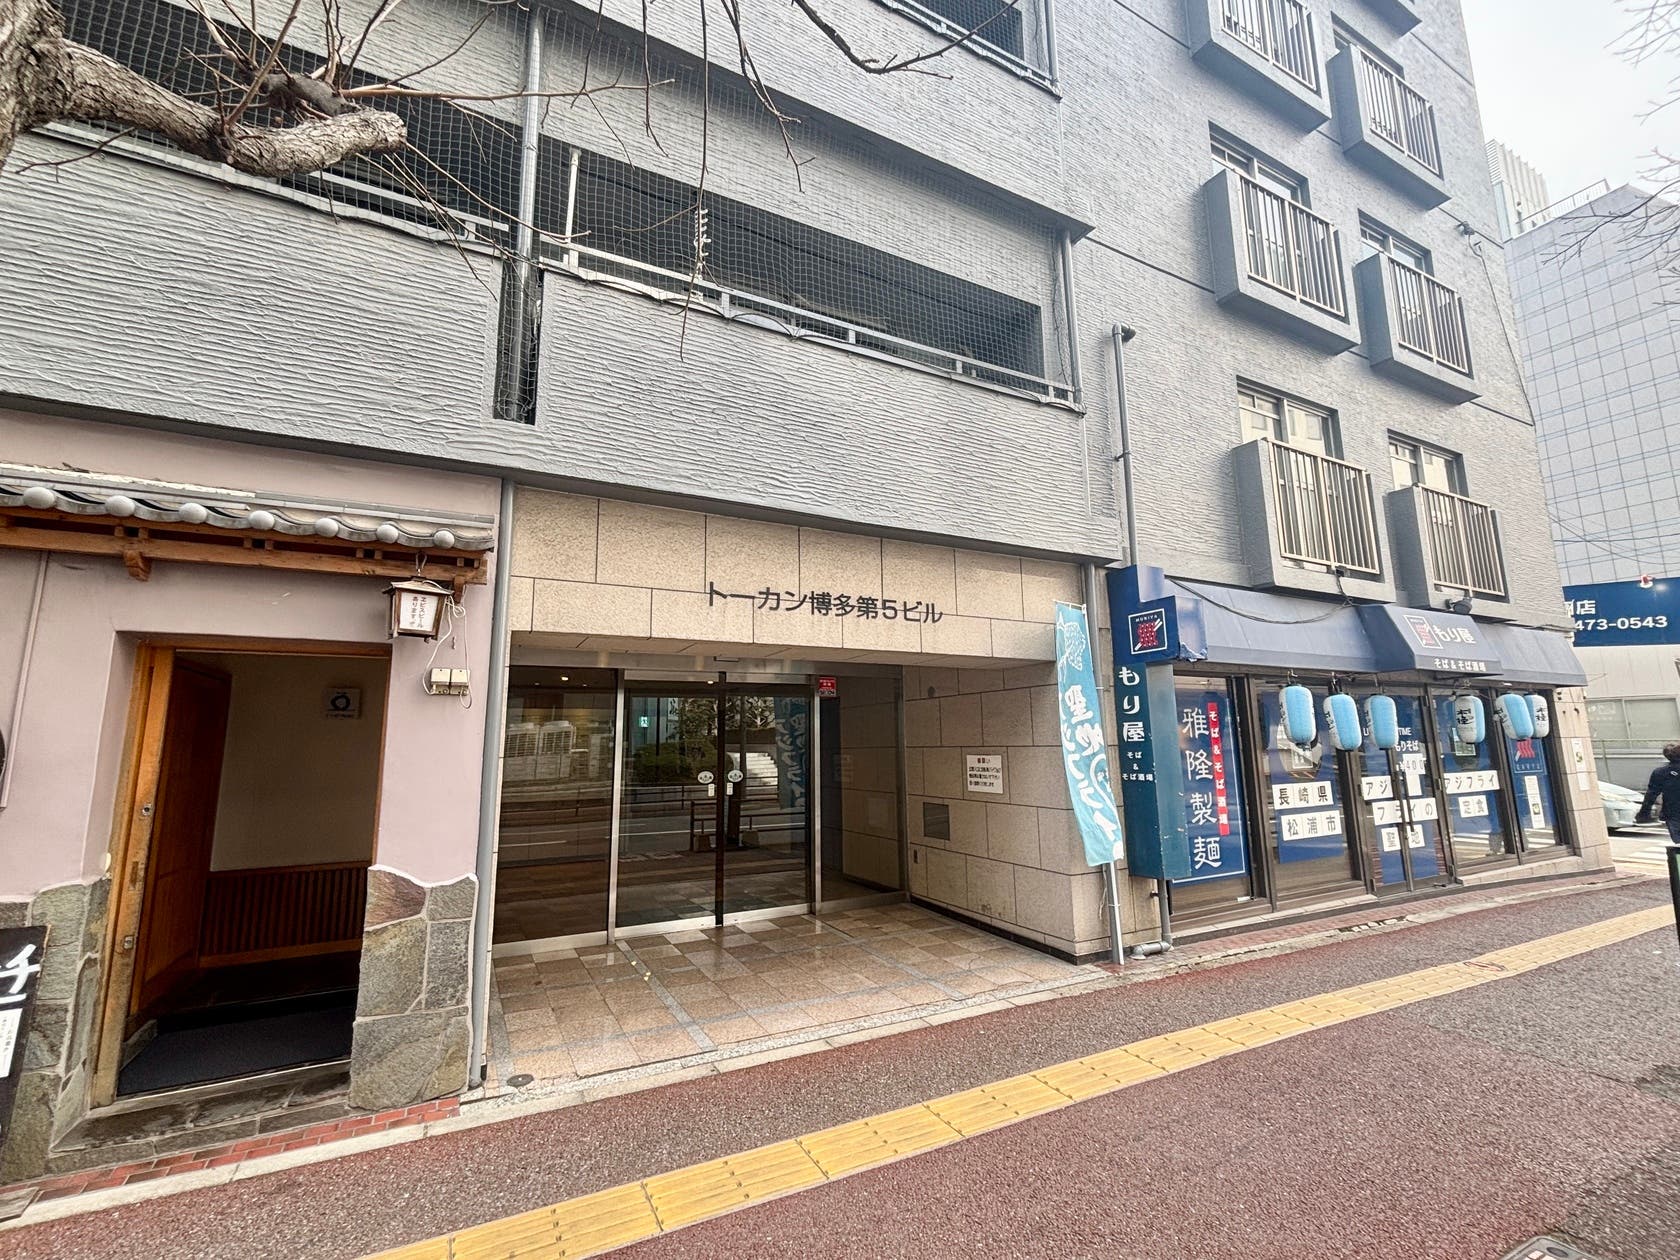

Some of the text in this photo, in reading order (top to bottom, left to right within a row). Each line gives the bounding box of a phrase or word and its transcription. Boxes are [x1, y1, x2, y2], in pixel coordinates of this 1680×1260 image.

[709, 581, 943, 624] トーカン博多第5ビル
[1574, 615, 1668, 631] 473-0543
[1432, 624, 1477, 644] もり屋
[1118, 666, 1145, 742] もり屋
[1127, 751, 1143, 759] そば
[1122, 773, 1154, 781] そば酒場
[1209, 711, 1229, 825] そば&そば酒場
[1279, 785, 1329, 806] 長崎県
[1365, 780, 1388, 796] アジ
[1287, 815, 1336, 837] 松浦市
